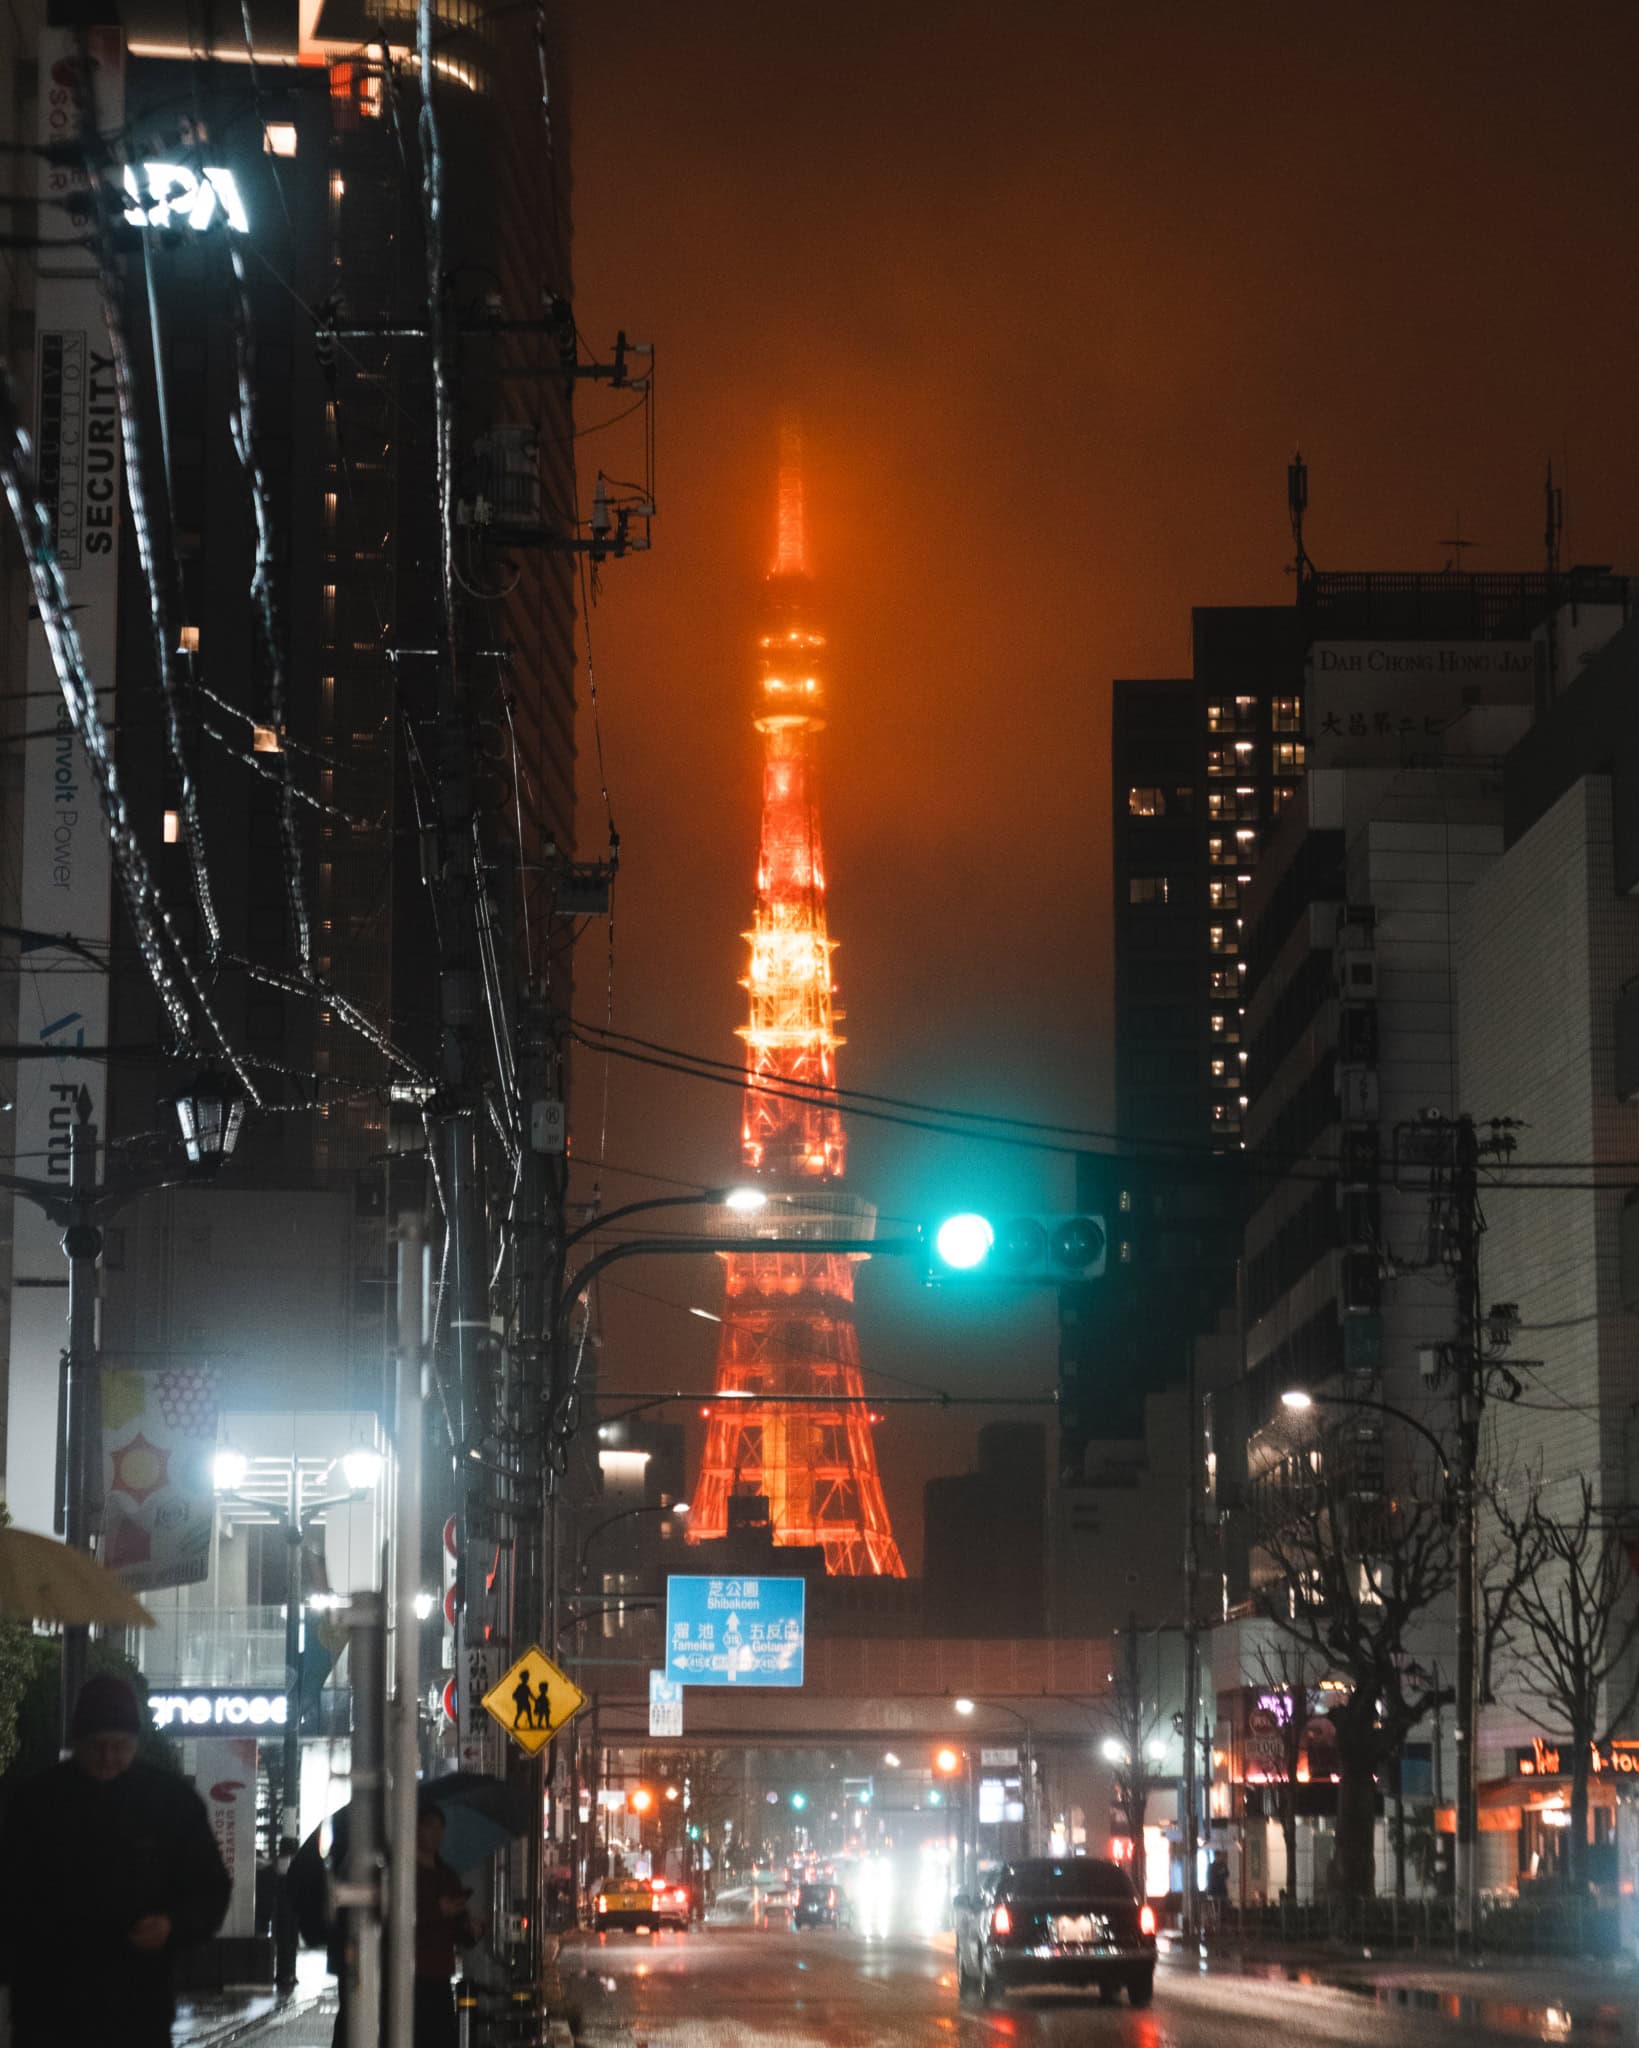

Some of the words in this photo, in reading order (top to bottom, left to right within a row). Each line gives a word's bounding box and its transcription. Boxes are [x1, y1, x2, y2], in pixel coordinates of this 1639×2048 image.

[49, 88, 69, 190] SOLR
[41, 336, 61, 545] ECUTIVE
[59, 338, 81, 562] PROTECTION
[85, 351, 116, 555] SECURITY
[54, 692, 79, 803] eenvolt
[52, 811, 79, 891] Power
[707, 1598, 760, 1610] Shibakoen
[708, 1580, 759, 1598] 芝公園
[672, 1640, 716, 1652] Tameike
[752, 1639, 798, 1653] Gotan
